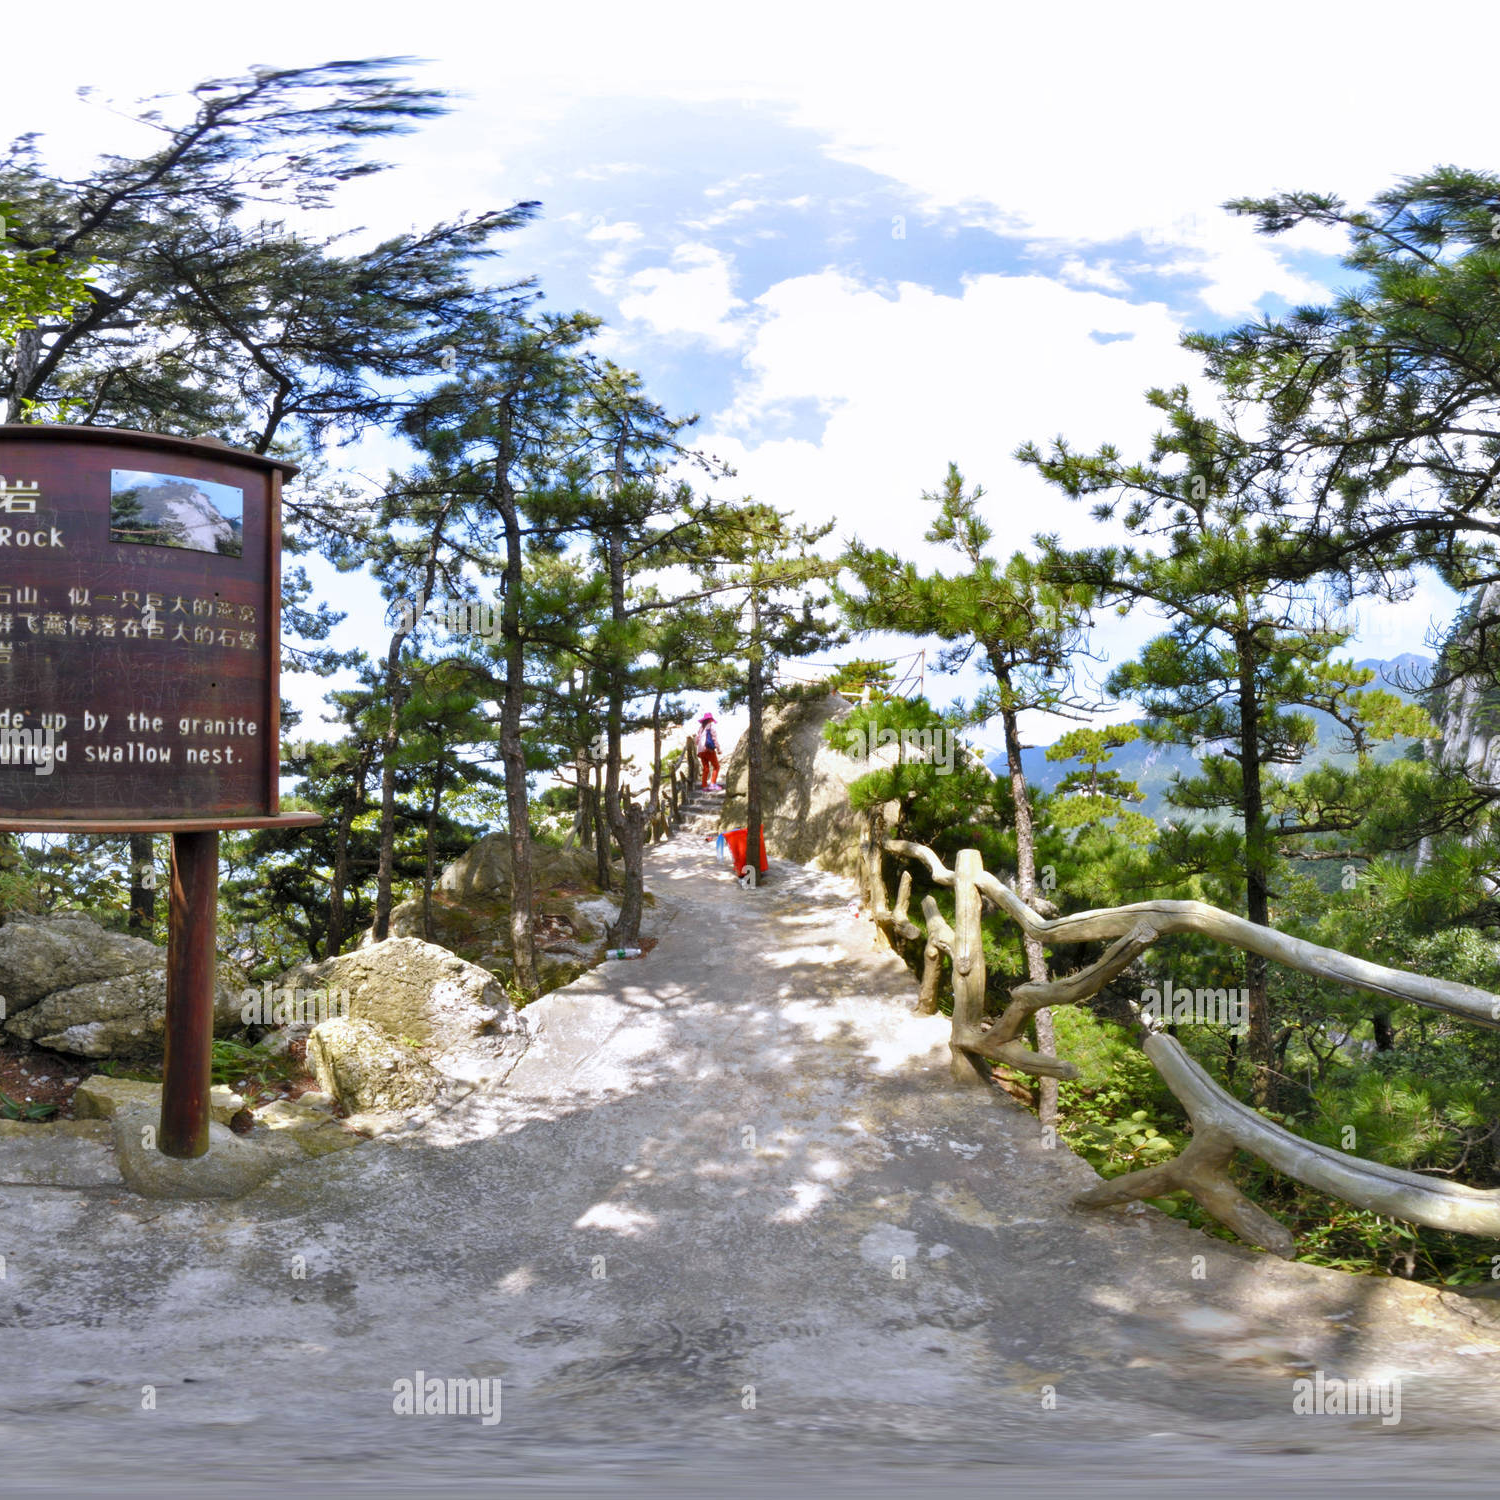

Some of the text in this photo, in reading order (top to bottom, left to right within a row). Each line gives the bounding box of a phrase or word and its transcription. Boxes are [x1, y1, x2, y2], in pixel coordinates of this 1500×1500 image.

[41, 712, 67, 733] up
[84, 709, 109, 733] by
[127, 712, 164, 733] the
[179, 717, 258, 736] granite
[85, 741, 172, 763] swallow
[186, 745, 243, 764] nest.
